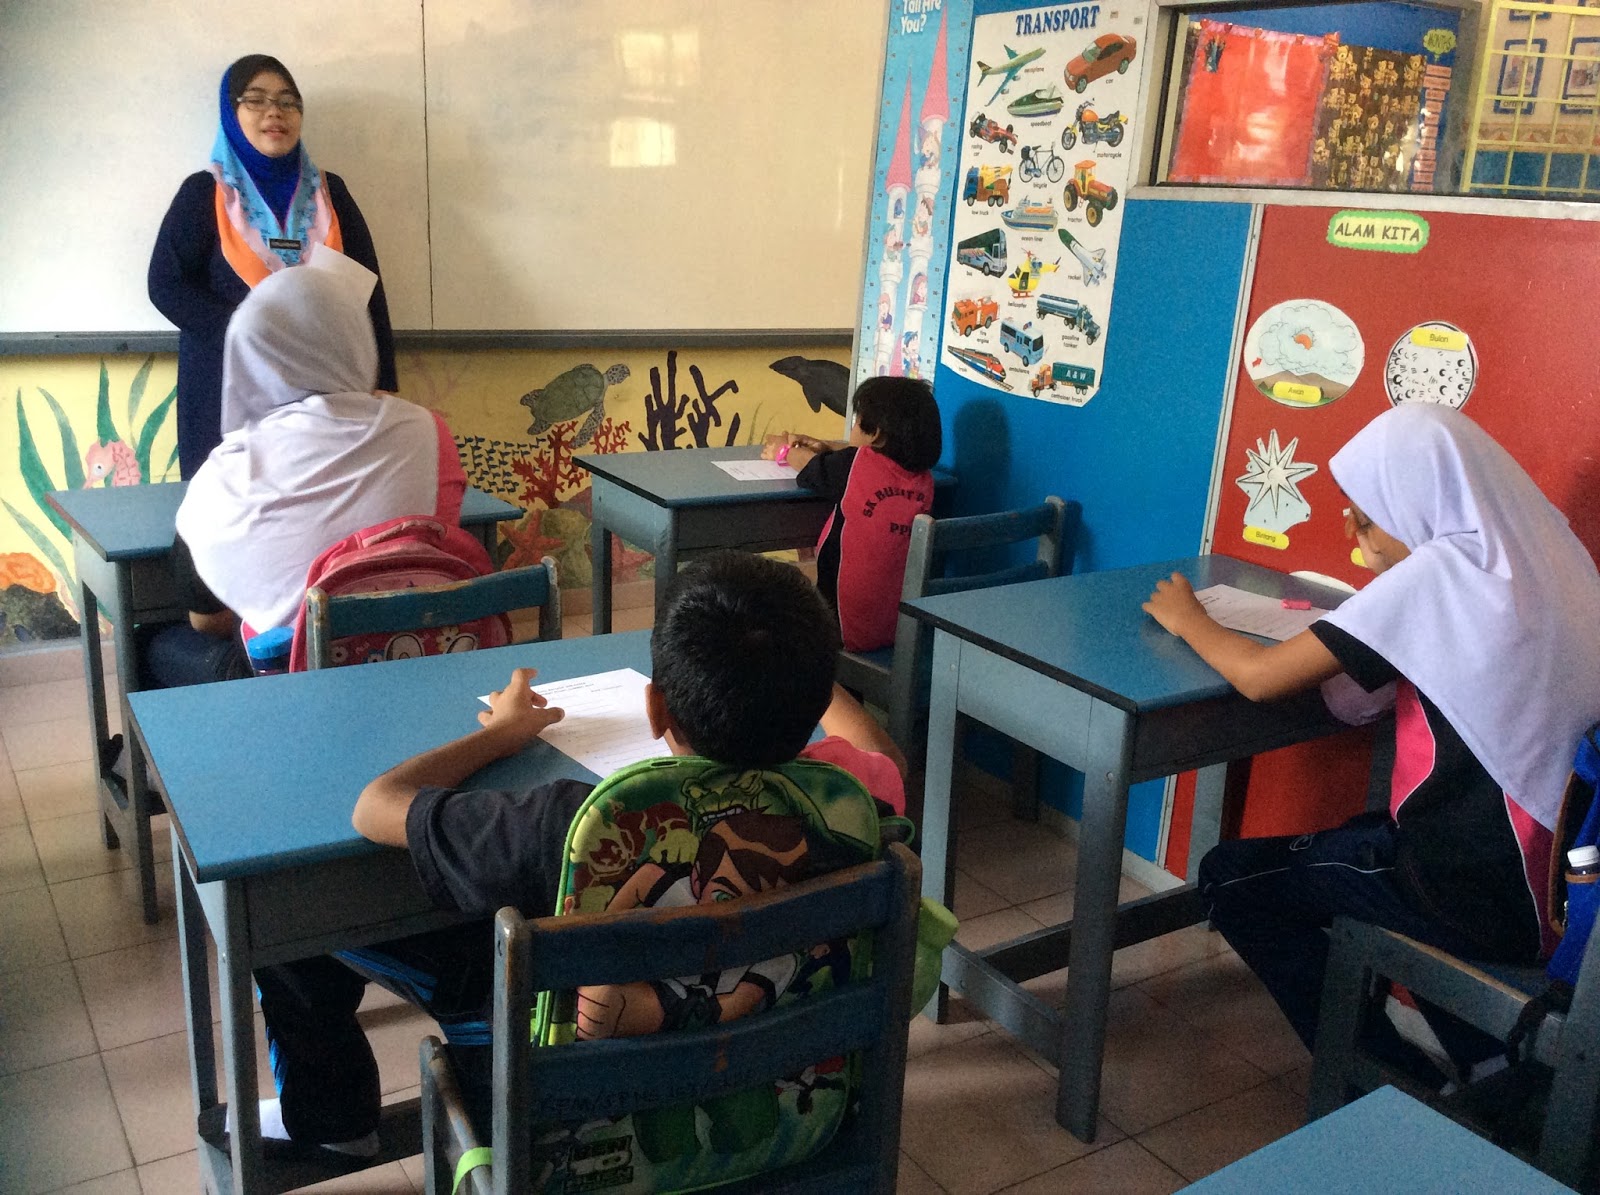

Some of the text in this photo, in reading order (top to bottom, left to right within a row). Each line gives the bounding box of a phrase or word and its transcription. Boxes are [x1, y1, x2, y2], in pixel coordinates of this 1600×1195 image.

[903, 0, 942, 14] Tall Are
[901, 13, 927, 36] You?
[1016, 5, 1100, 36] TRANSPORT
[1096, 151, 1122, 159] motorcycle
[1334, 222, 1420, 242] ALAM KITA
[1065, 369, 1072, 378] A
[1079, 372, 1087, 381] W
[863, 487, 914, 518] SK BUKIT
[1255, 531, 1277, 543] Bintang
